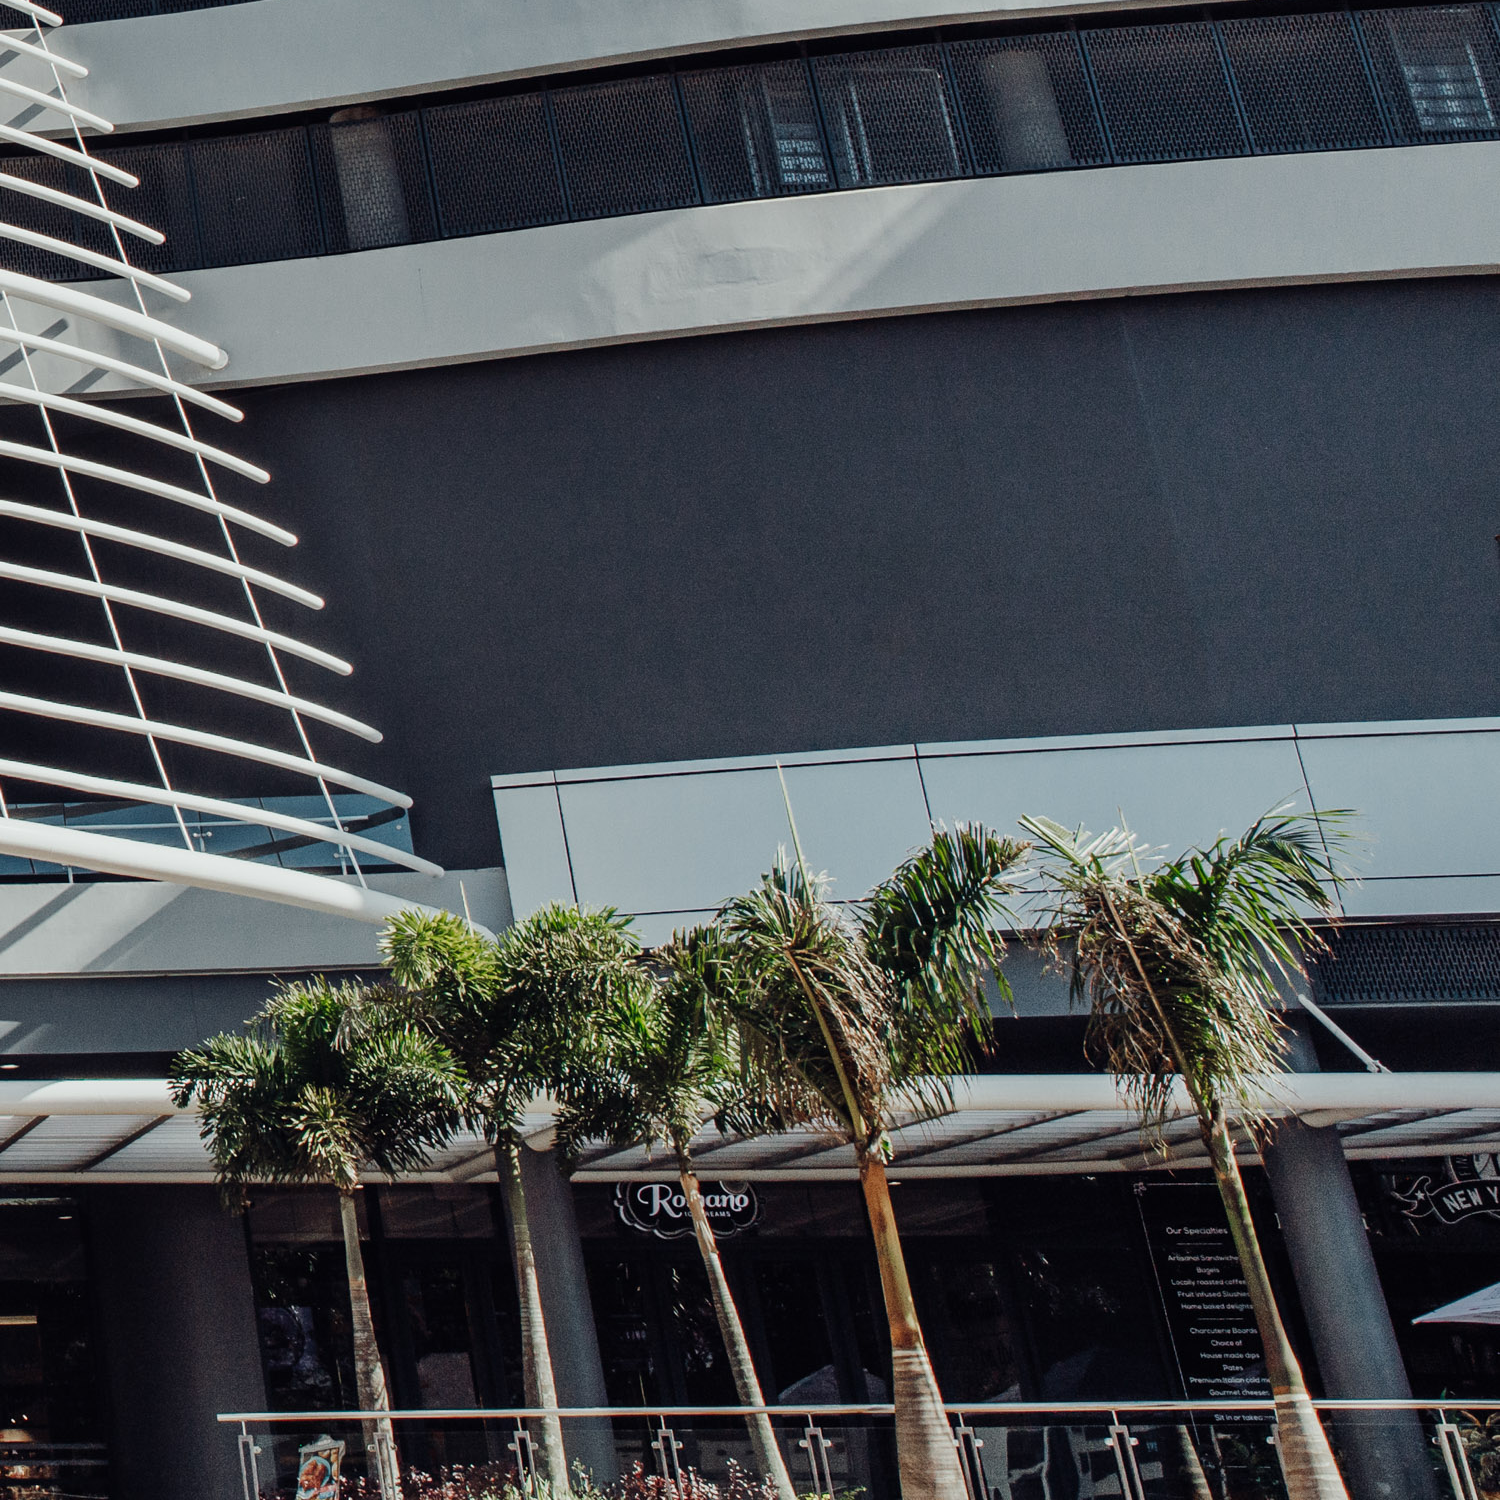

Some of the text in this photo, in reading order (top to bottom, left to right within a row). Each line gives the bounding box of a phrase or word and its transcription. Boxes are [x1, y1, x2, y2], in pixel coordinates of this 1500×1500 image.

[637, 1184, 749, 1218] Roano
[1442, 1187, 1483, 1214] NEW
[705, 1210, 731, 1218] REAMS
[1166, 1226, 1228, 1236] Our Specialties
[1177, 1290, 1194, 1298] Fruit
[1195, 1290, 1221, 1298] infused
[1226, 1303, 1254, 1312] delights
[1210, 1339, 1234, 1347] Choice
[1245, 1352, 1260, 1360] dips
[1214, 1413, 1224, 1421] Sit
[1225, 1413, 1233, 1421] in
